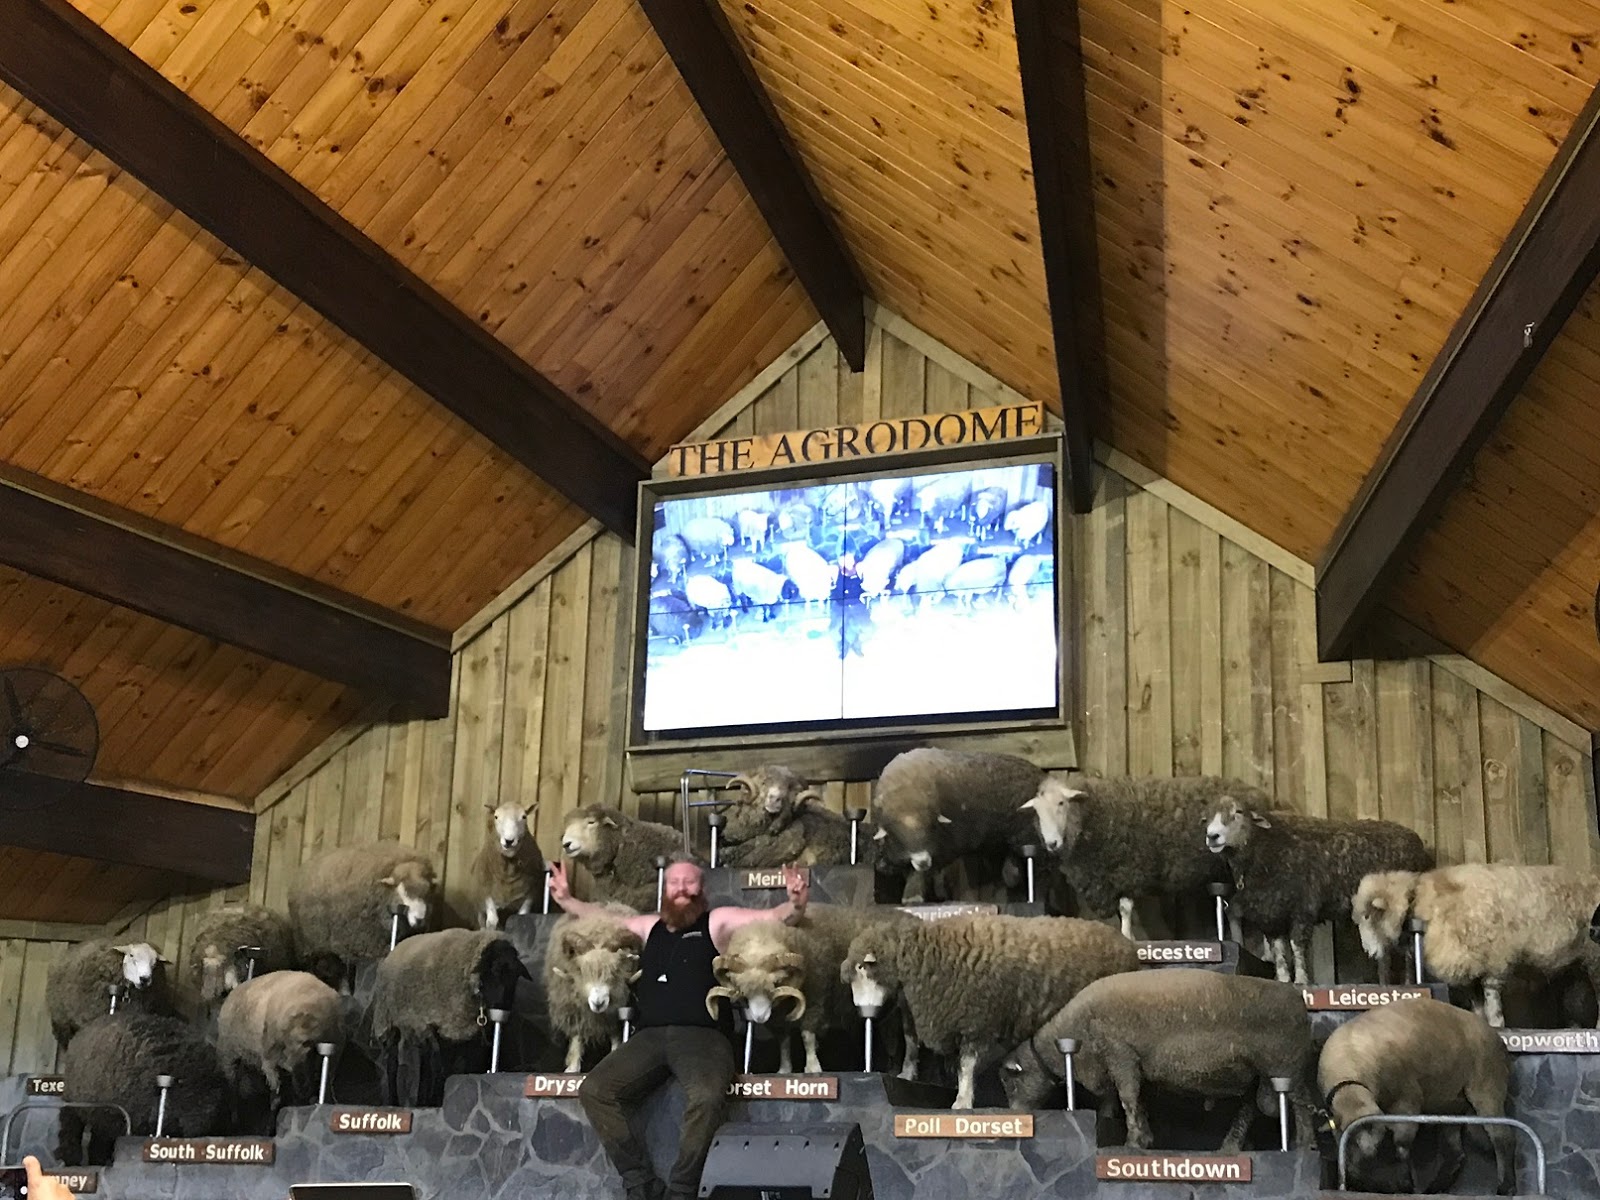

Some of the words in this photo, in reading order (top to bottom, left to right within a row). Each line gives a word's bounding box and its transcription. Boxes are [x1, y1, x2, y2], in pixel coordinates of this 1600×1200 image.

[671, 438, 754, 477] THE
[770, 405, 1041, 467] AGRODOME
[1137, 944, 1213, 961] eicester
[33, 1079, 65, 1093] Texe
[726, 1080, 772, 1096] orset
[785, 1079, 829, 1096] Horn
[338, 1112, 403, 1130] Suffolk
[904, 1118, 941, 1134] Poll
[954, 1118, 1023, 1134] Dorset
[149, 1143, 196, 1161] South
[205, 1143, 265, 1161] Suffolk
[1106, 1159, 1241, 1179] Southdown
